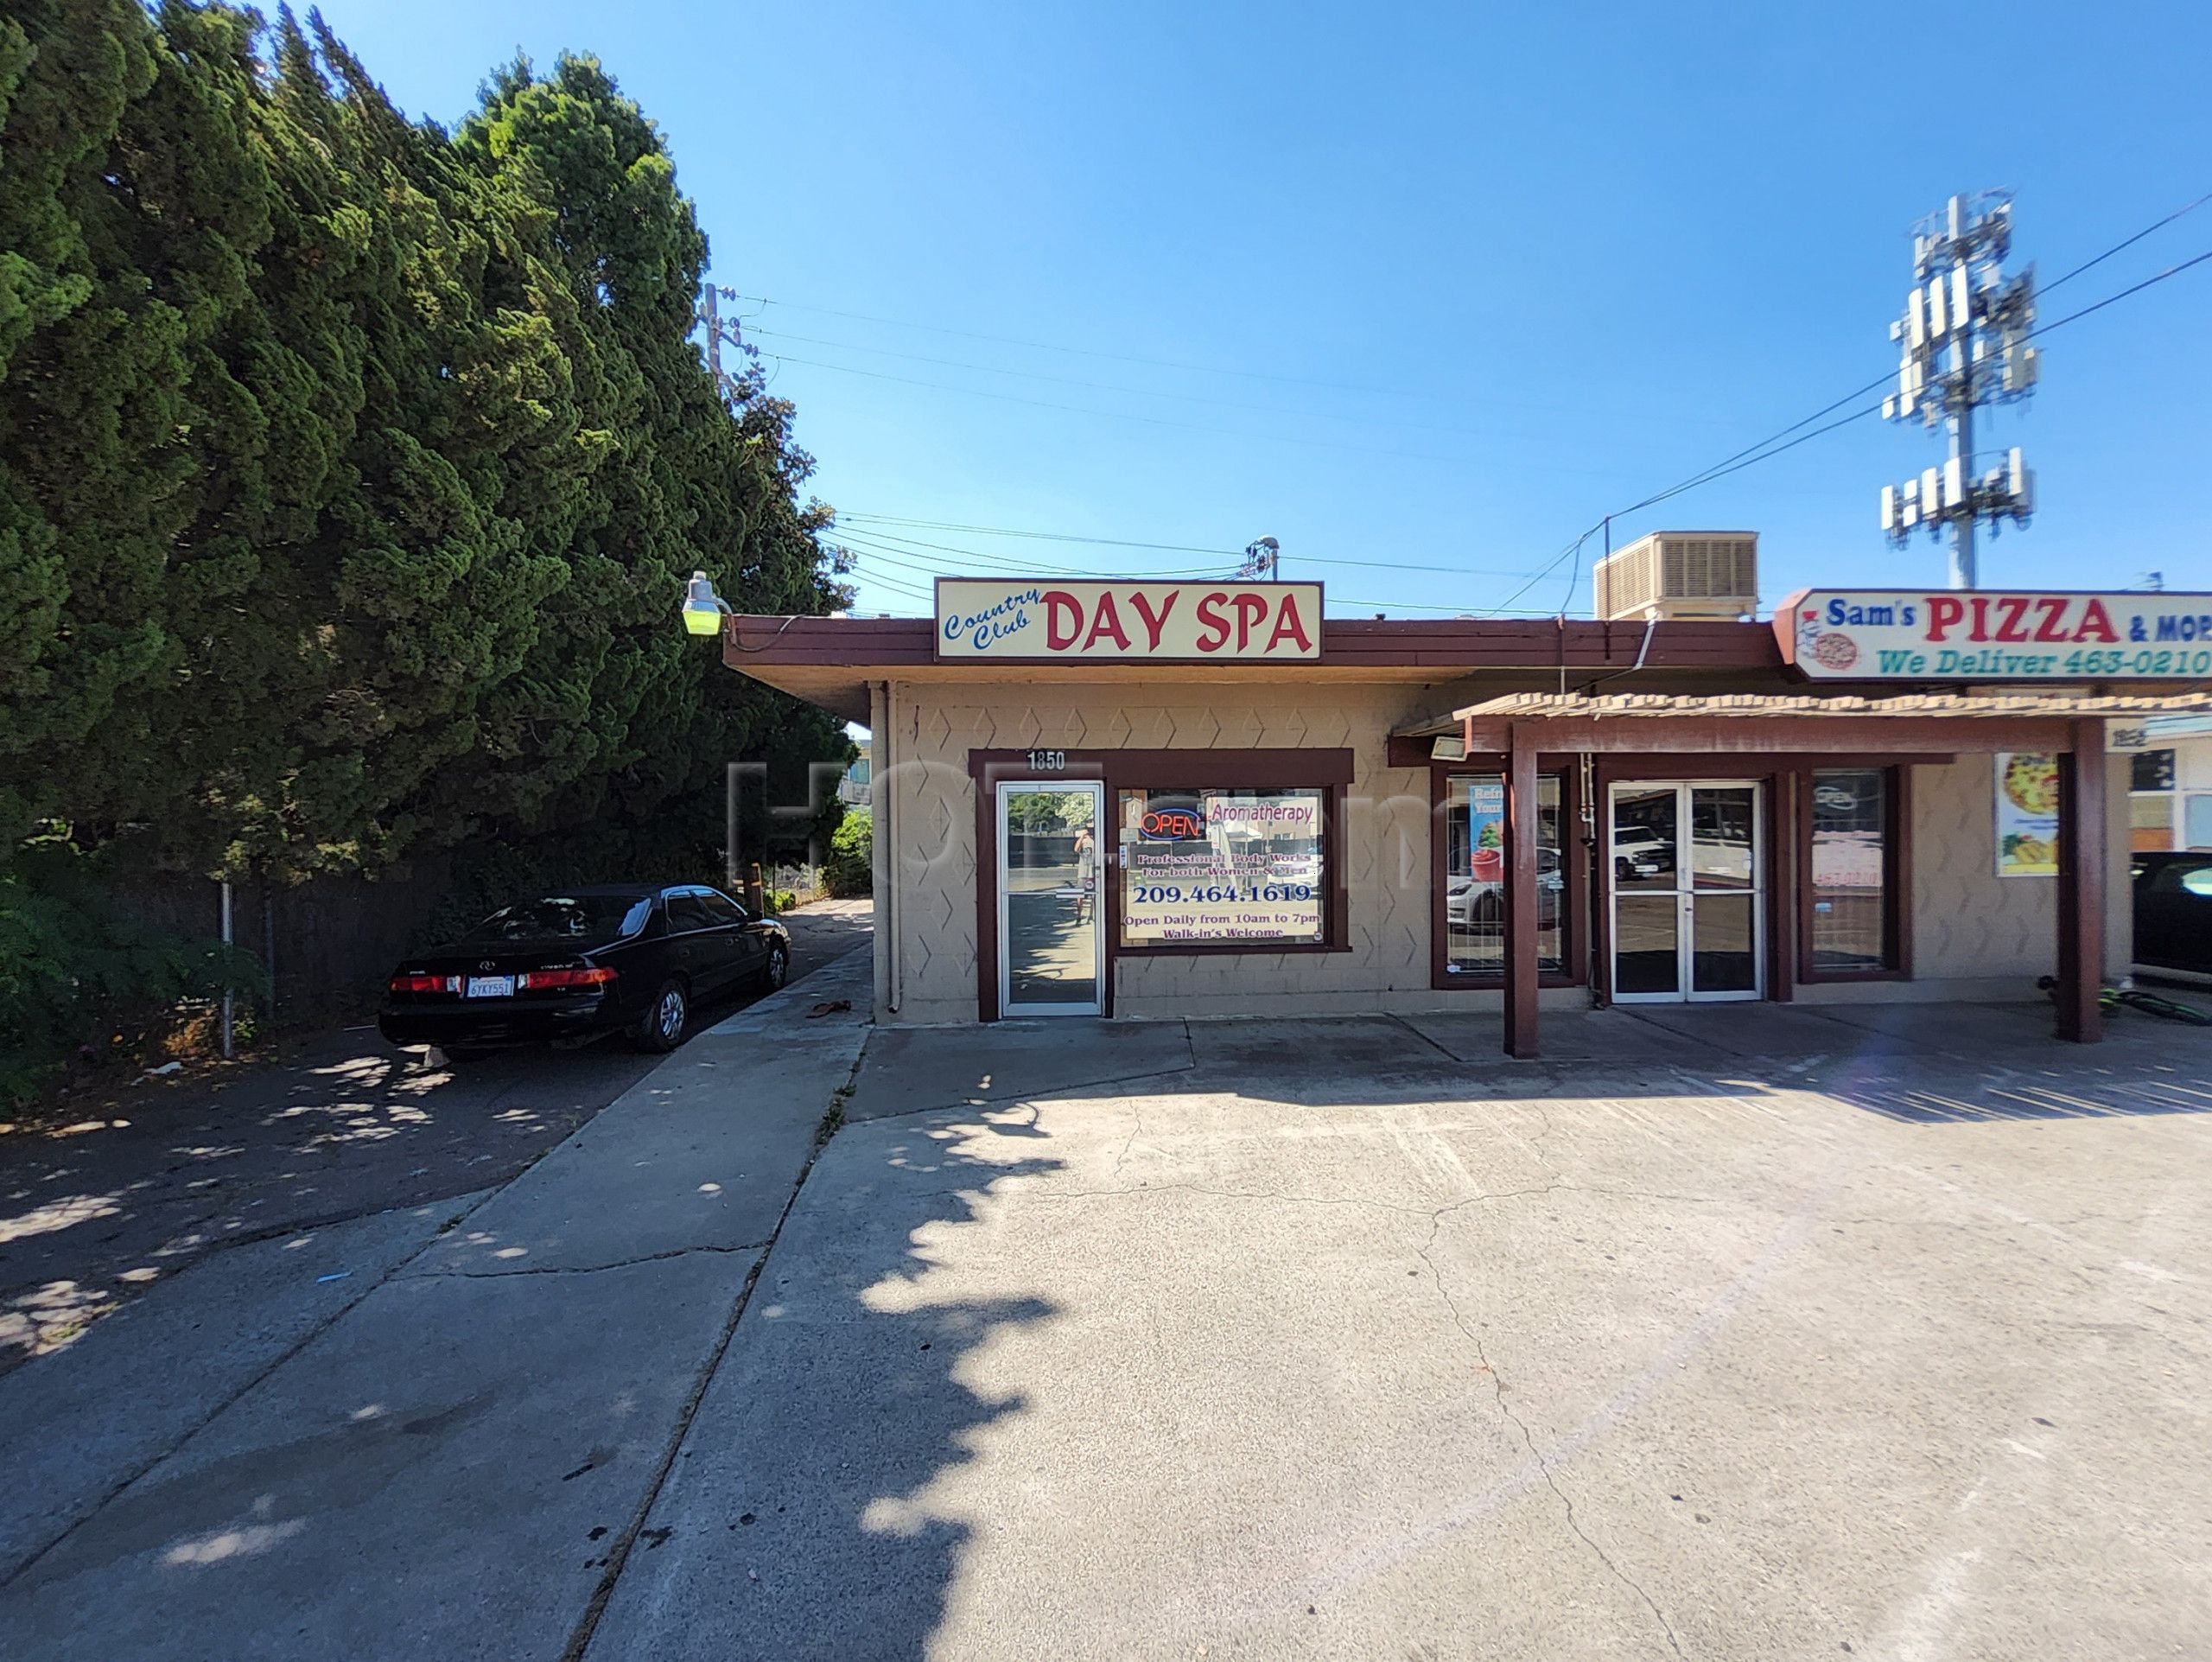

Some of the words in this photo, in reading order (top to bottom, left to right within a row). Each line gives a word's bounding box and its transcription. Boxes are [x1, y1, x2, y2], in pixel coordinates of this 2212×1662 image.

[944, 589, 1041, 640] Country
[1039, 589, 1180, 653] DAY
[1196, 591, 1313, 655] SPA
[1826, 598, 1917, 627] Sam's
[1923, 596, 2121, 643] PIZZA
[2129, 614, 2149, 642] &
[973, 609, 1032, 650] Club
[1877, 649, 1927, 673] We
[1933, 648, 2058, 673] Deliver
[2063, 650, 2212, 674] 463-0210
[1027, 751, 1065, 770] 1850
[1141, 812, 1200, 837] OPEN
[1211, 803, 1313, 825] Aromatherapy
[1137, 854, 1225, 864] Professional
[1230, 853, 1266, 864] Body
[1268, 852, 1312, 863] Works
[1142, 867, 1165, 877] For
[1169, 867, 1203, 877] both
[1206, 867, 1258, 876] Women
[1262, 867, 1275, 876] &
[1278, 866, 1308, 876] Men
[1133, 884, 1312, 904] 209.464.1619
[1124, 915, 1159, 926] Open
[1163, 914, 1196, 926] Daily
[1199, 914, 1230, 924] from
[1235, 914, 1271, 924] 10am
[1274, 914, 1288, 923] to
[1292, 913, 1321, 925] 7pm
[1162, 928, 1222, 939] Walk-in's
[1225, 927, 1284, 939] Welcome
[471, 984, 509, 995] 6YKY551
